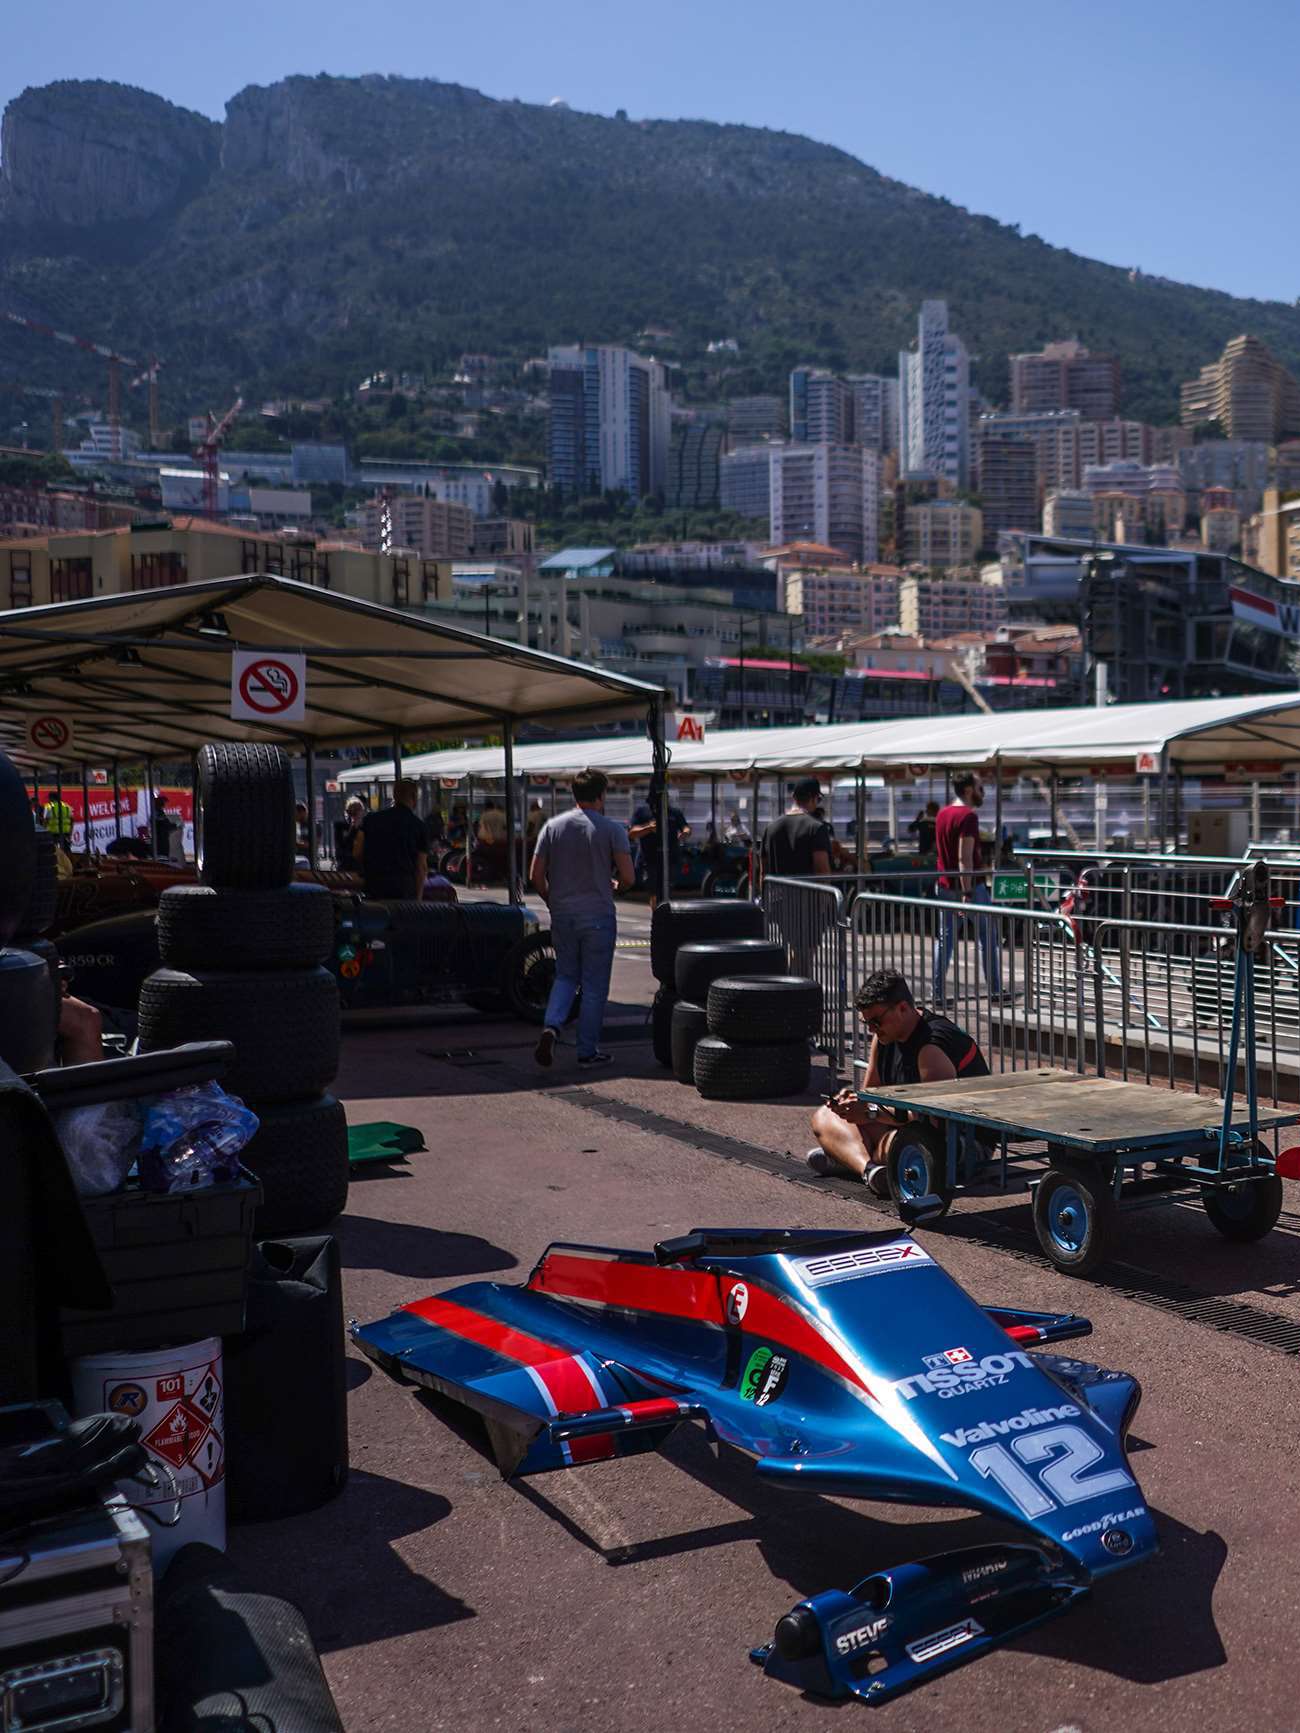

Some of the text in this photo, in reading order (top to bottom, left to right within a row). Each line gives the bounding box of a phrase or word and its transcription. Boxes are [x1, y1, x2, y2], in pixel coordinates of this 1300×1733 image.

[806, 1246, 921, 1276] ESSEX
[160, 1377, 181, 1393] 101
[893, 1351, 1035, 1400] TISSOT
[938, 1374, 1009, 1399] QUARTZ
[939, 1404, 1081, 1448] Valvoline
[968, 1424, 1136, 1520] 12
[1061, 1507, 1145, 1542] GOODYEAR
